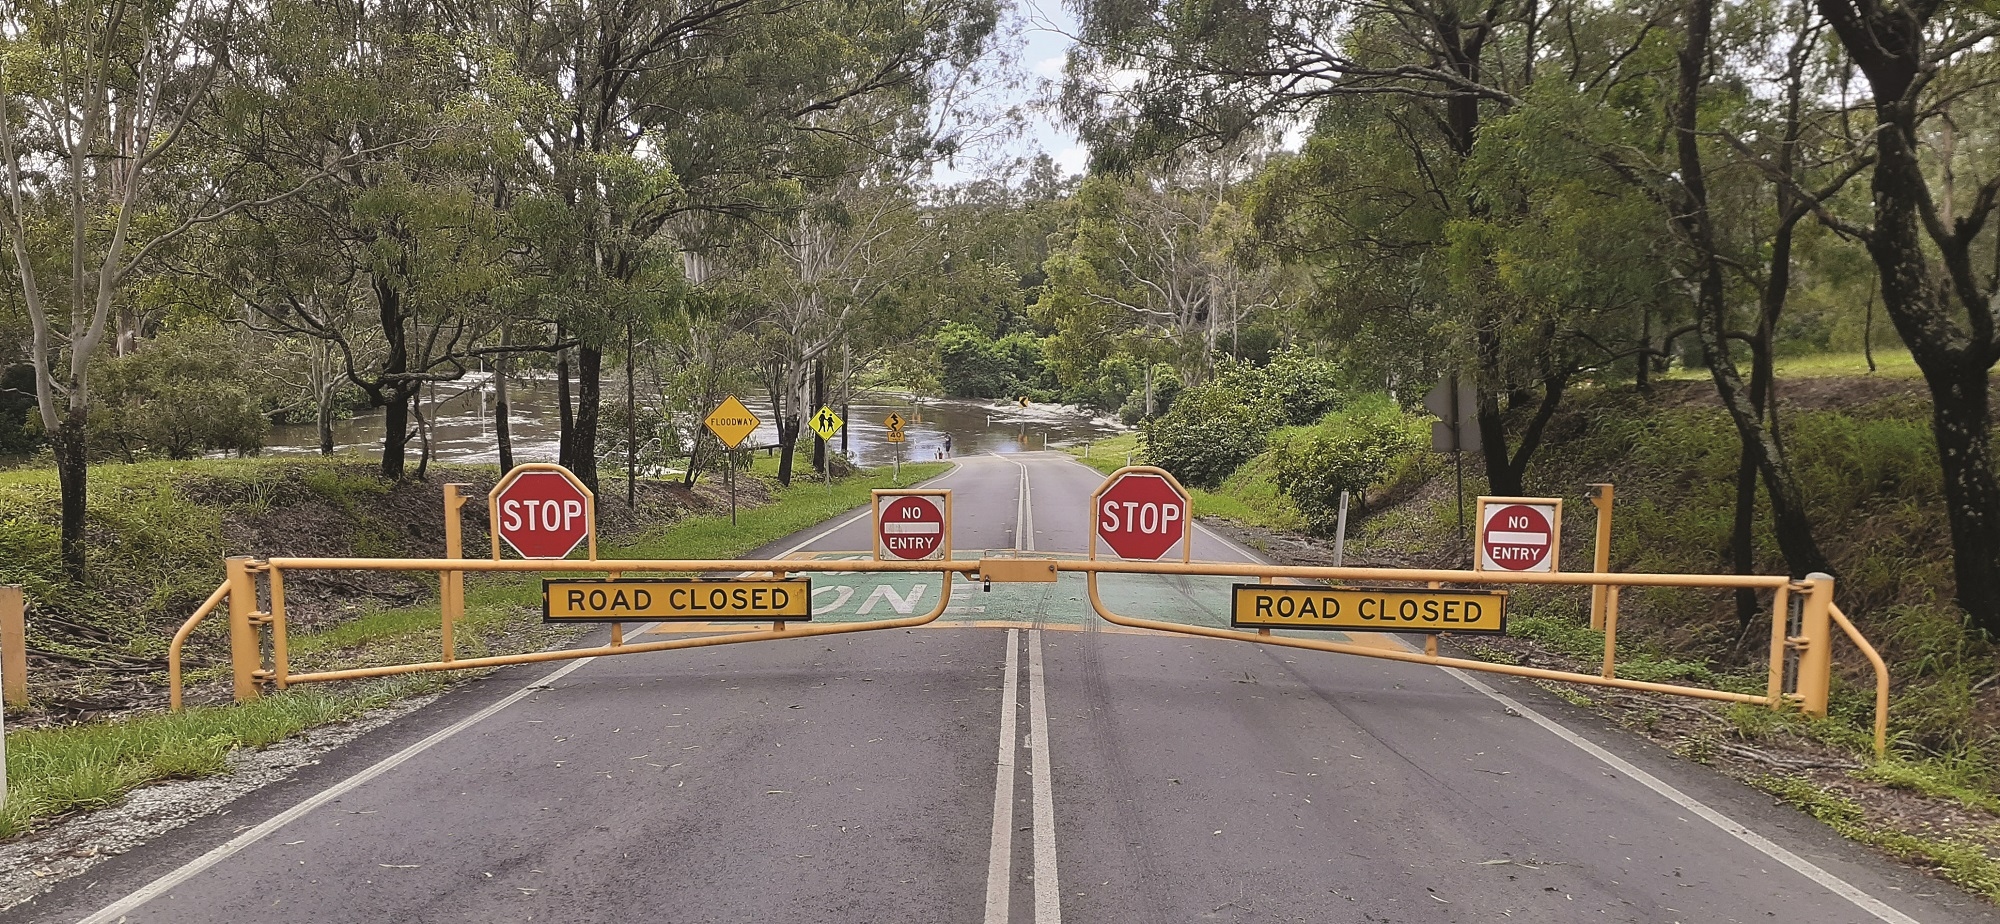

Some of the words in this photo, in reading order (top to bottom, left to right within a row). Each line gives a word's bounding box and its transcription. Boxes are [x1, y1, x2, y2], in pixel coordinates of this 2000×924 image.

[710, 417, 754, 426] FLOODWAY
[503, 499, 582, 531] STOP
[902, 506, 921, 519] NO
[1102, 500, 1180, 534] STOP
[1508, 516, 1529, 530] NO
[889, 537, 934, 549] ENTRY
[1492, 547, 1541, 560] ENTRY
[568, 588, 652, 611] ROAD
[669, 588, 789, 611] CLOSED
[811, 583, 986, 615] ONE
[1255, 595, 1340, 618] ROAD
[1358, 598, 1482, 622] CLOSED
